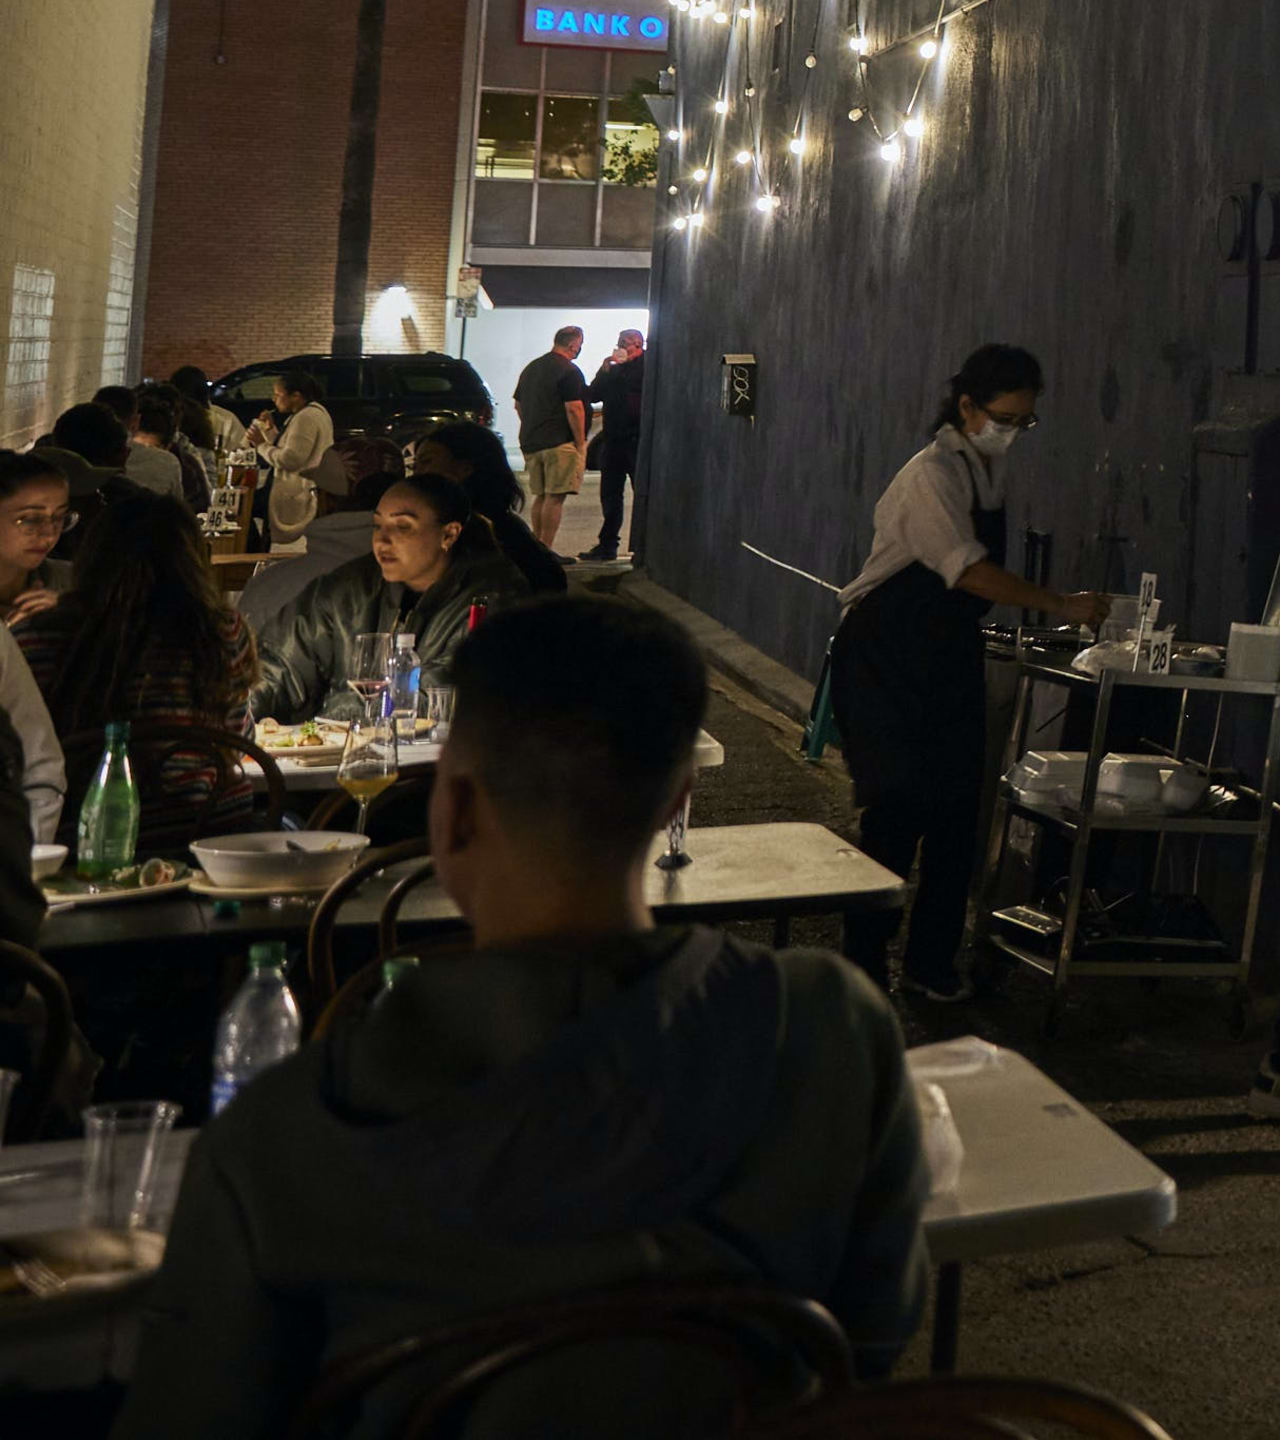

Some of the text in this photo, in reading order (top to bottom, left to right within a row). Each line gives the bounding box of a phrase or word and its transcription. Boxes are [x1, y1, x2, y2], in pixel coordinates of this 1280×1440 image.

[535, 8, 664, 39] BANK O
[209, 510, 223, 528] 46
[1151, 642, 1168, 671] 28
